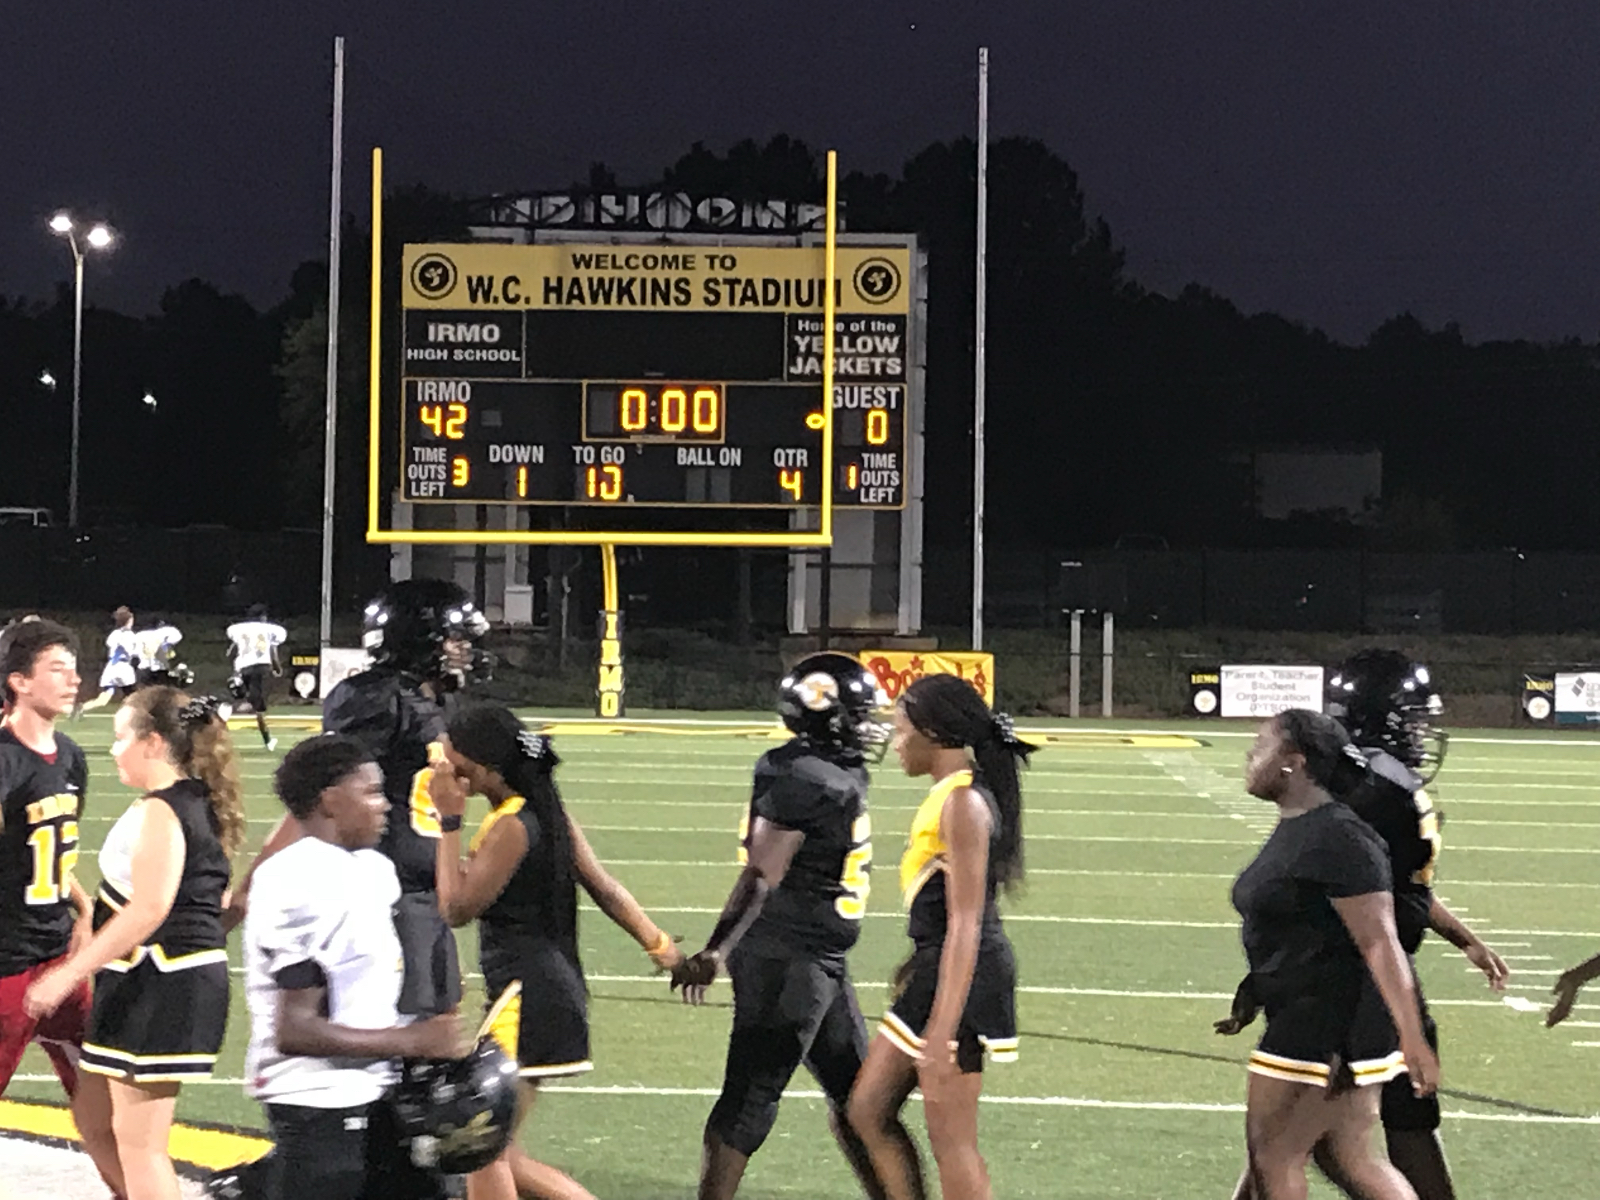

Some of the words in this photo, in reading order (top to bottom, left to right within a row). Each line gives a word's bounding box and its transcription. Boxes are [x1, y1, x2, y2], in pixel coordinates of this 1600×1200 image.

[572, 253, 696, 271] WELCOME
[705, 254, 737, 271] TO
[466, 275, 531, 305] W.C.
[543, 276, 692, 307] HAWKINS
[703, 277, 842, 308] STADIUM
[427, 321, 501, 343] IRMO
[849, 319, 867, 332] of
[870, 320, 897, 333] the
[407, 348, 449, 361] HIGH
[453, 348, 521, 362] SCHOOL
[789, 356, 903, 375] JAKETS
[417, 380, 472, 403] IRMO
[832, 384, 900, 409] GUEST
[621, 388, 718, 433] 0:00
[420, 404, 468, 440] 42
[866, 409, 888, 445] 0
[412, 446, 448, 463] TIME
[488, 444, 544, 464] DOWN
[572, 445, 595, 464] TO
[600, 446, 625, 465] GO
[677, 447, 715, 466] BALL
[719, 447, 742, 467] ON
[773, 448, 808, 468] QTR
[861, 452, 897, 469] TIME
[407, 463, 447, 480] OUTS
[452, 457, 469, 487] 3
[517, 465, 528, 498] 1
[860, 470, 900, 486] OUTS
[410, 481, 446, 498] LEFT
[779, 469, 802, 501] 4
[860, 487, 896, 503] LEFT
